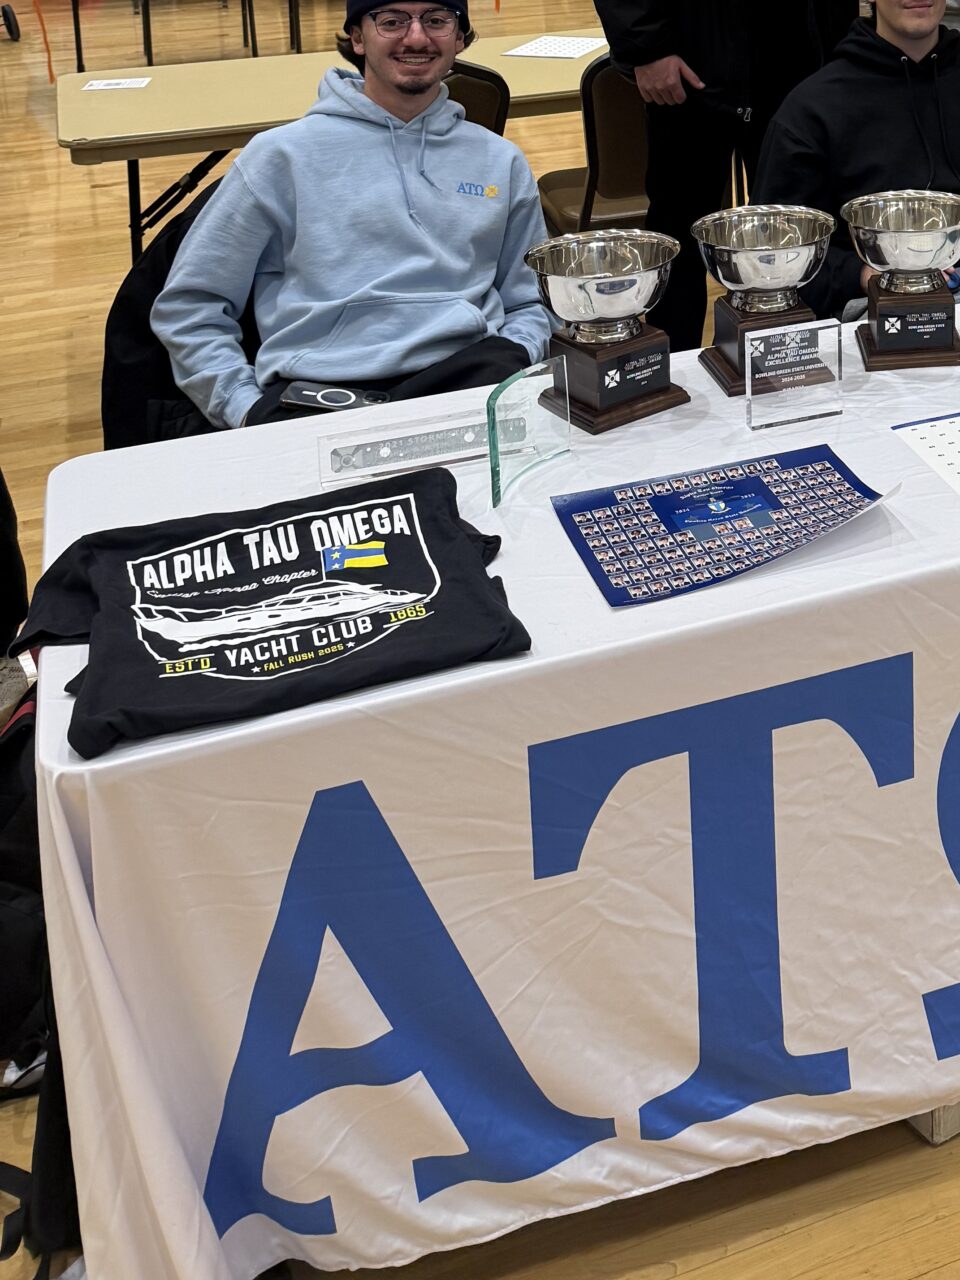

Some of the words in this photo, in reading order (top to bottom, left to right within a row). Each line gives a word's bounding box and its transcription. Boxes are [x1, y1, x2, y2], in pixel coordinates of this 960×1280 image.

[764, 356, 800, 367] EXCELLENCE
[767, 351, 786, 361] ALPHA
[798, 347, 819, 355] OMEGA
[143, 541, 236, 590] ALPHA
[243, 523, 300, 570] TAU
[310, 504, 412, 552] OMEGA
[262, 568, 319, 586] Chapter
[388, 604, 427, 625] 1865
[223, 634, 301, 668] YACHT
[312, 616, 373, 647] CLUB
[165, 656, 211, 674] EST'D
[263, 659, 286, 672] FALL
[288, 651, 315, 664] RUSH
[317, 643, 345, 658] 2025
